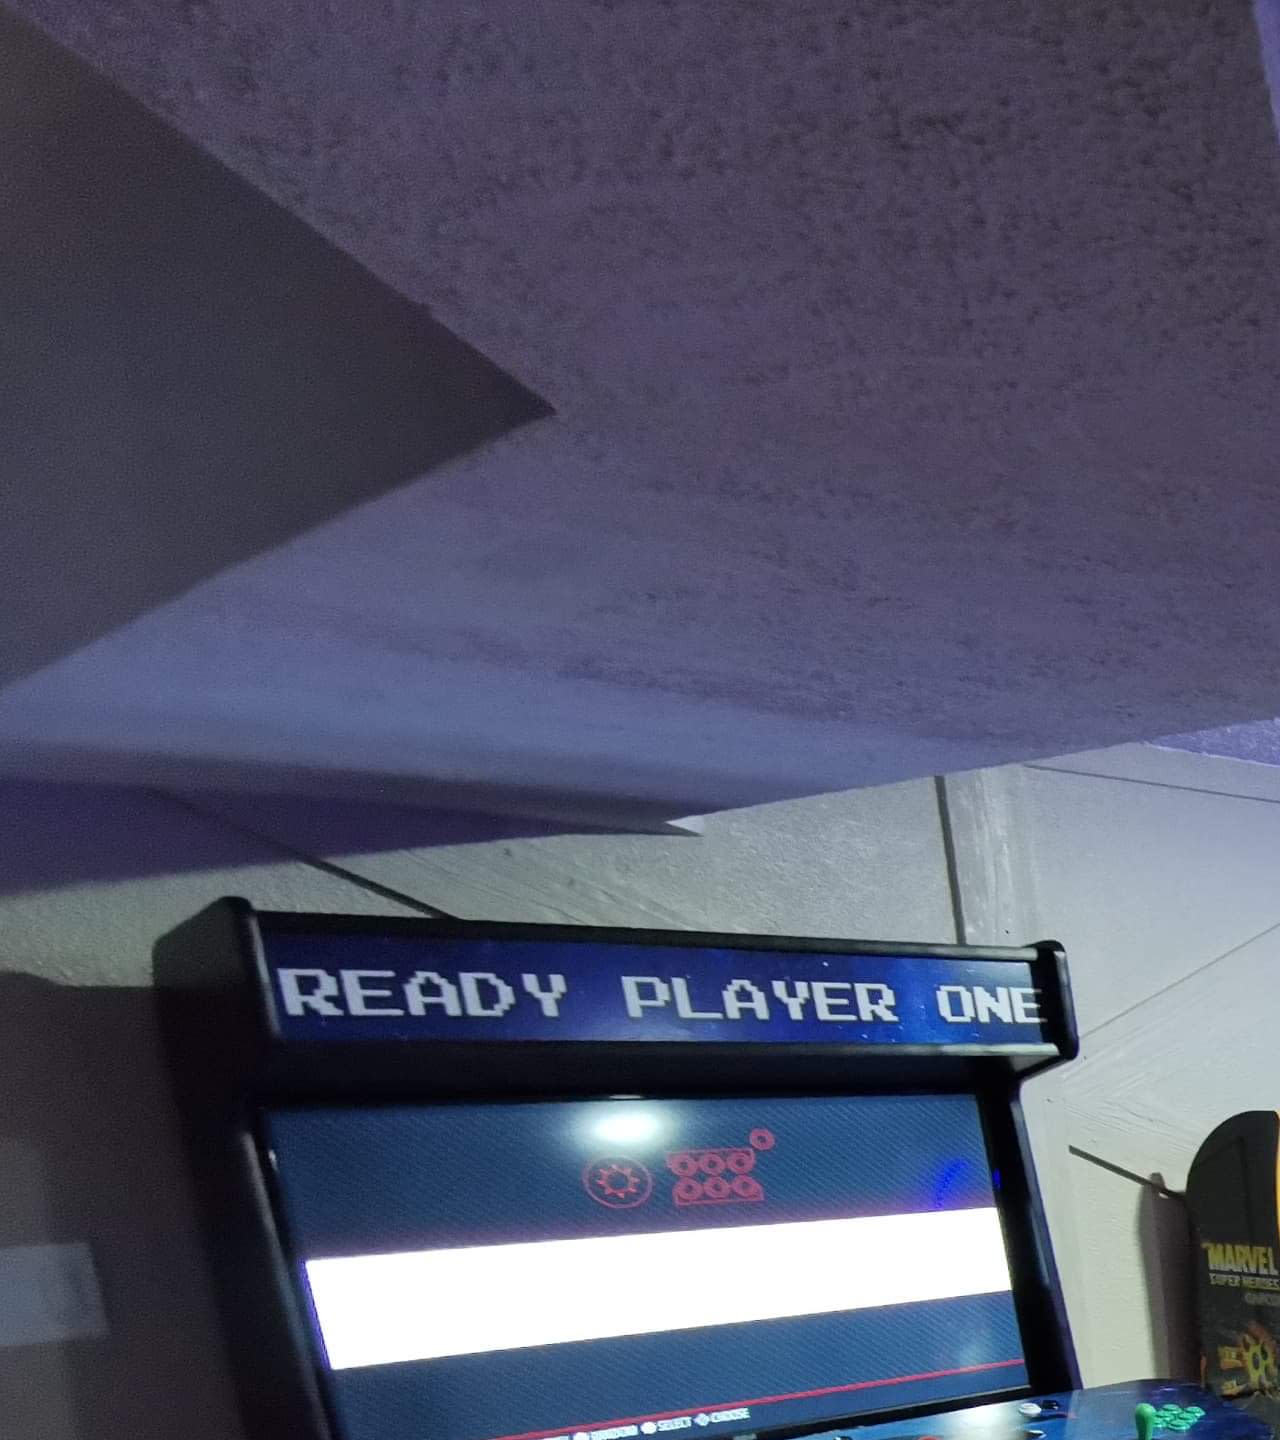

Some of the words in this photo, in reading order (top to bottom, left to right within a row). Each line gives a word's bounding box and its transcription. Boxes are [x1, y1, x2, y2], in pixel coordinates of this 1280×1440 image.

[276, 967, 567, 1017] READY
[621, 974, 899, 1023] PLAYER
[935, 984, 1047, 1024] ONE
[1202, 1243, 1279, 1275] MARVEL
